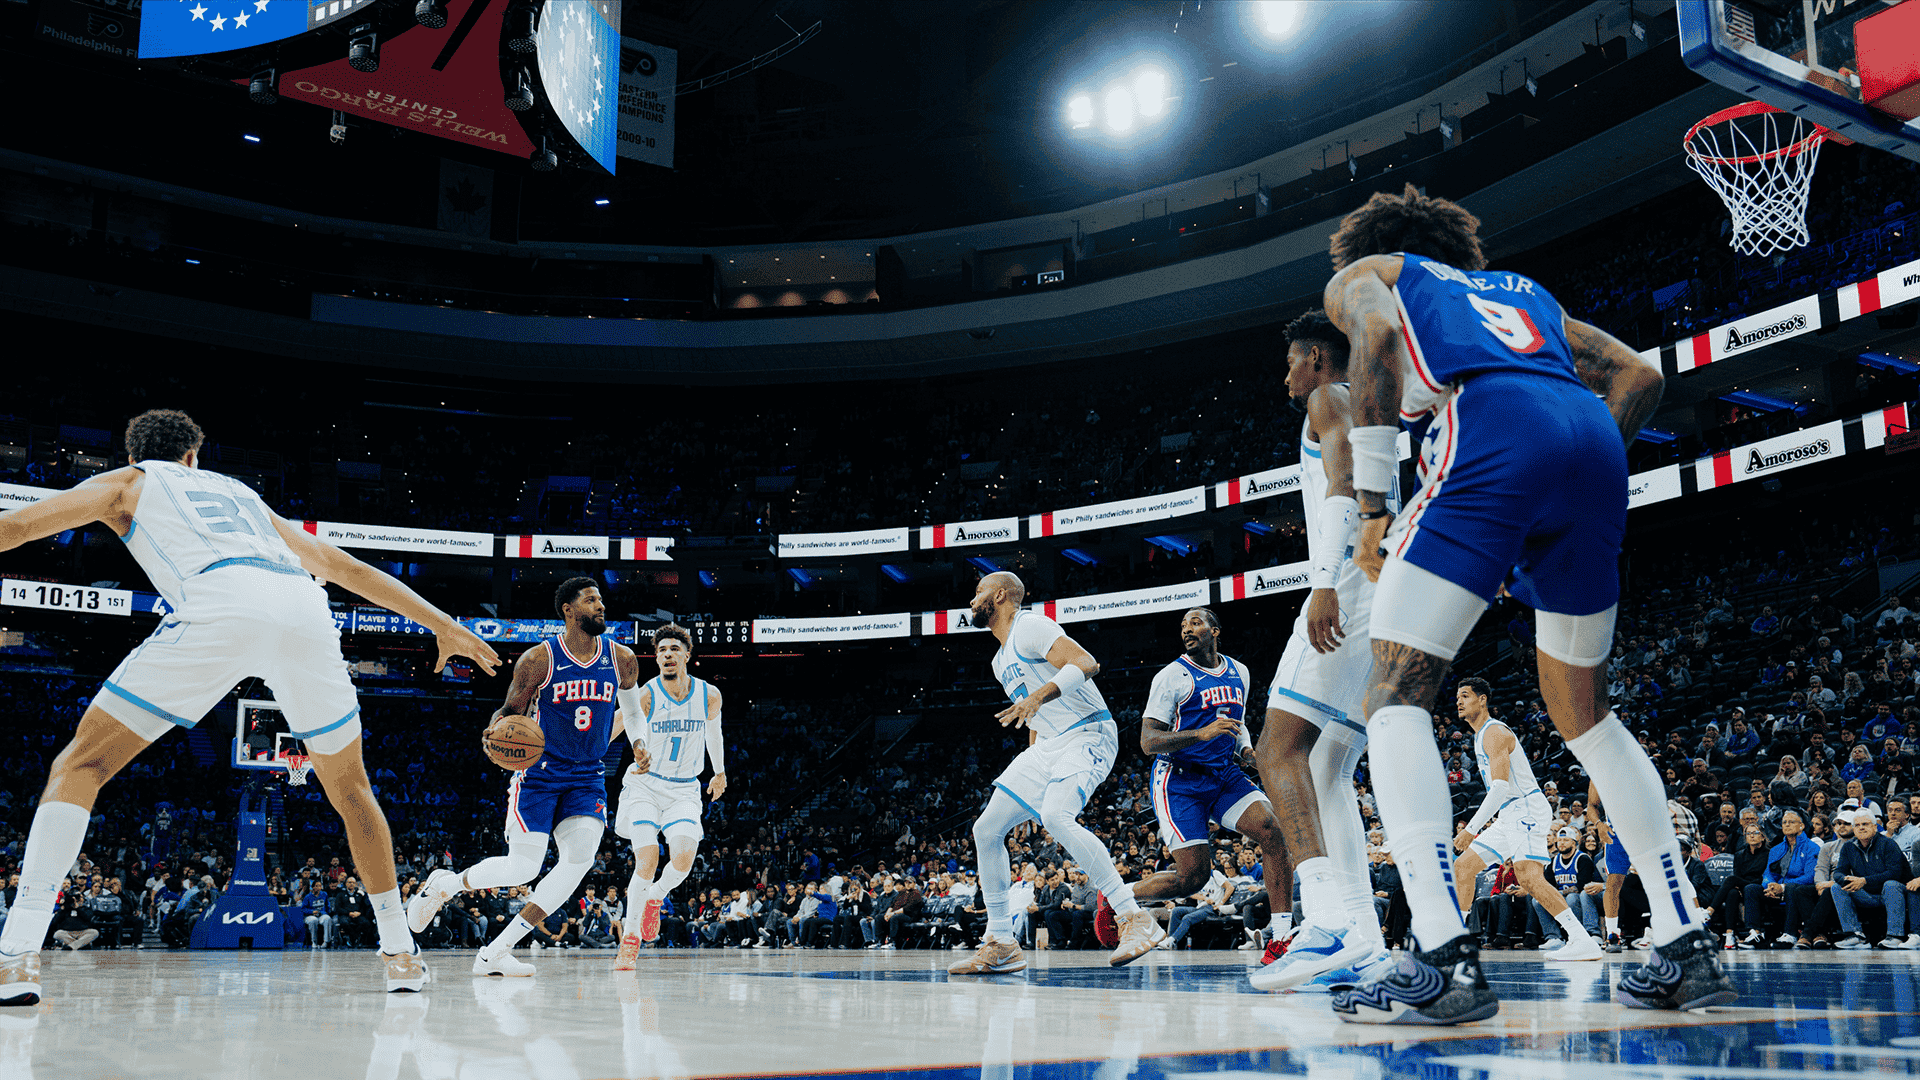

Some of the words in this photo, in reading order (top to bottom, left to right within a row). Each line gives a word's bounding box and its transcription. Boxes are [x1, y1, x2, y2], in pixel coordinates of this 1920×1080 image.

[42, 25, 123, 55] Philadelphia
[295, 81, 402, 116] FARGO
[366, 89, 457, 119] CENTER
[407, 111, 508, 144] WELLS
[617, 129, 656, 148] 2009-10
[1500, 275, 1536, 296] JR.
[1903, 273, 1920, 287] Wh
[1466, 293, 1546, 353] 9
[1724, 315, 1806, 352] Amoroso's
[1746, 439, 1830, 473] Amoroso's
[1247, 476, 1301, 495] Amoroso's
[185, 491, 281, 539] 31
[328, 530, 343, 539] Why
[345, 531, 366, 540] Philly
[368, 533, 411, 543] sandwiches
[541, 539, 599, 554] Amoroso's
[955, 528, 1010, 541] Amoroso's
[1254, 573, 1309, 590] Amoroso's
[11, 587, 27, 600] 14
[35, 585, 100, 610] 10:13
[107, 597, 125, 607] 1ST
[334, 611, 348, 620] TOL
[358, 614, 386, 623] PLAYER
[390, 616, 400, 624] 10
[358, 624, 386, 633] POINTS
[552, 679, 615, 704] PHILA
[1200, 685, 1244, 710] PHILA
[574, 706, 593, 731] 8
[651, 719, 705, 733] CHARLOTT
[669, 737, 682, 762] 1
